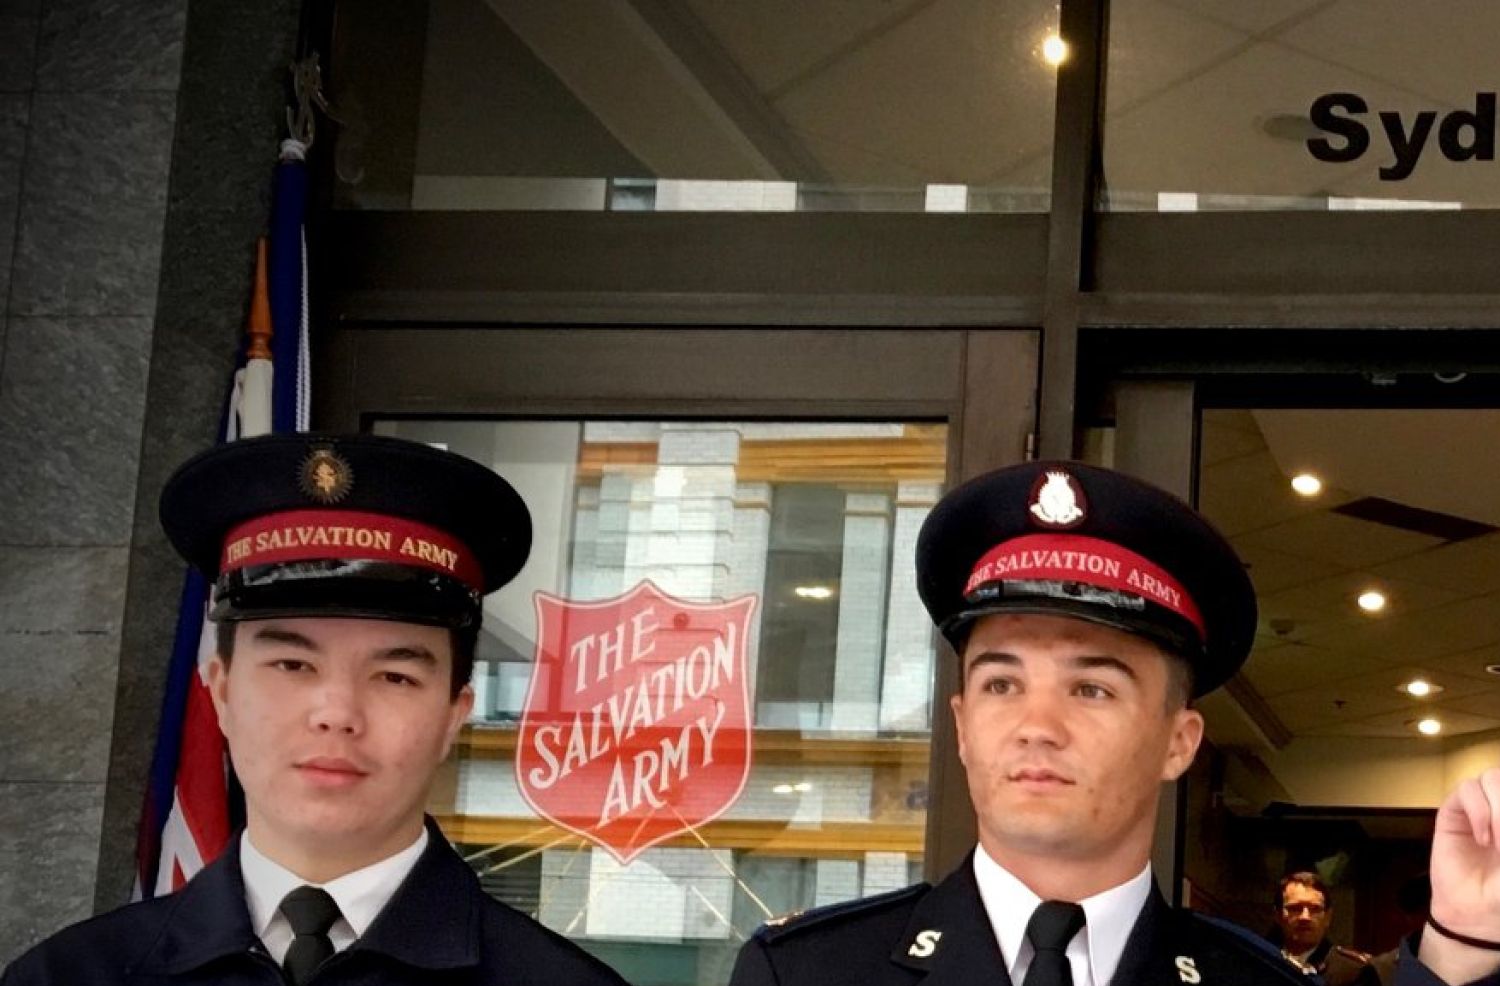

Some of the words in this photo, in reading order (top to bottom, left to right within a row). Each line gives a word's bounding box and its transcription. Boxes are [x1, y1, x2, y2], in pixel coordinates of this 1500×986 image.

[227, 537, 252, 563] THE
[256, 527, 391, 551] SALVATION
[400, 536, 458, 571] ARMY
[994, 551, 1121, 578] SALVATION
[1126, 569, 1181, 608] ARMY
[571, 607, 660, 693] THE
[529, 622, 736, 790] SALVATION
[597, 700, 726, 829] ARMY
[908, 930, 942, 957] S
[1175, 956, 1201, 984] S
